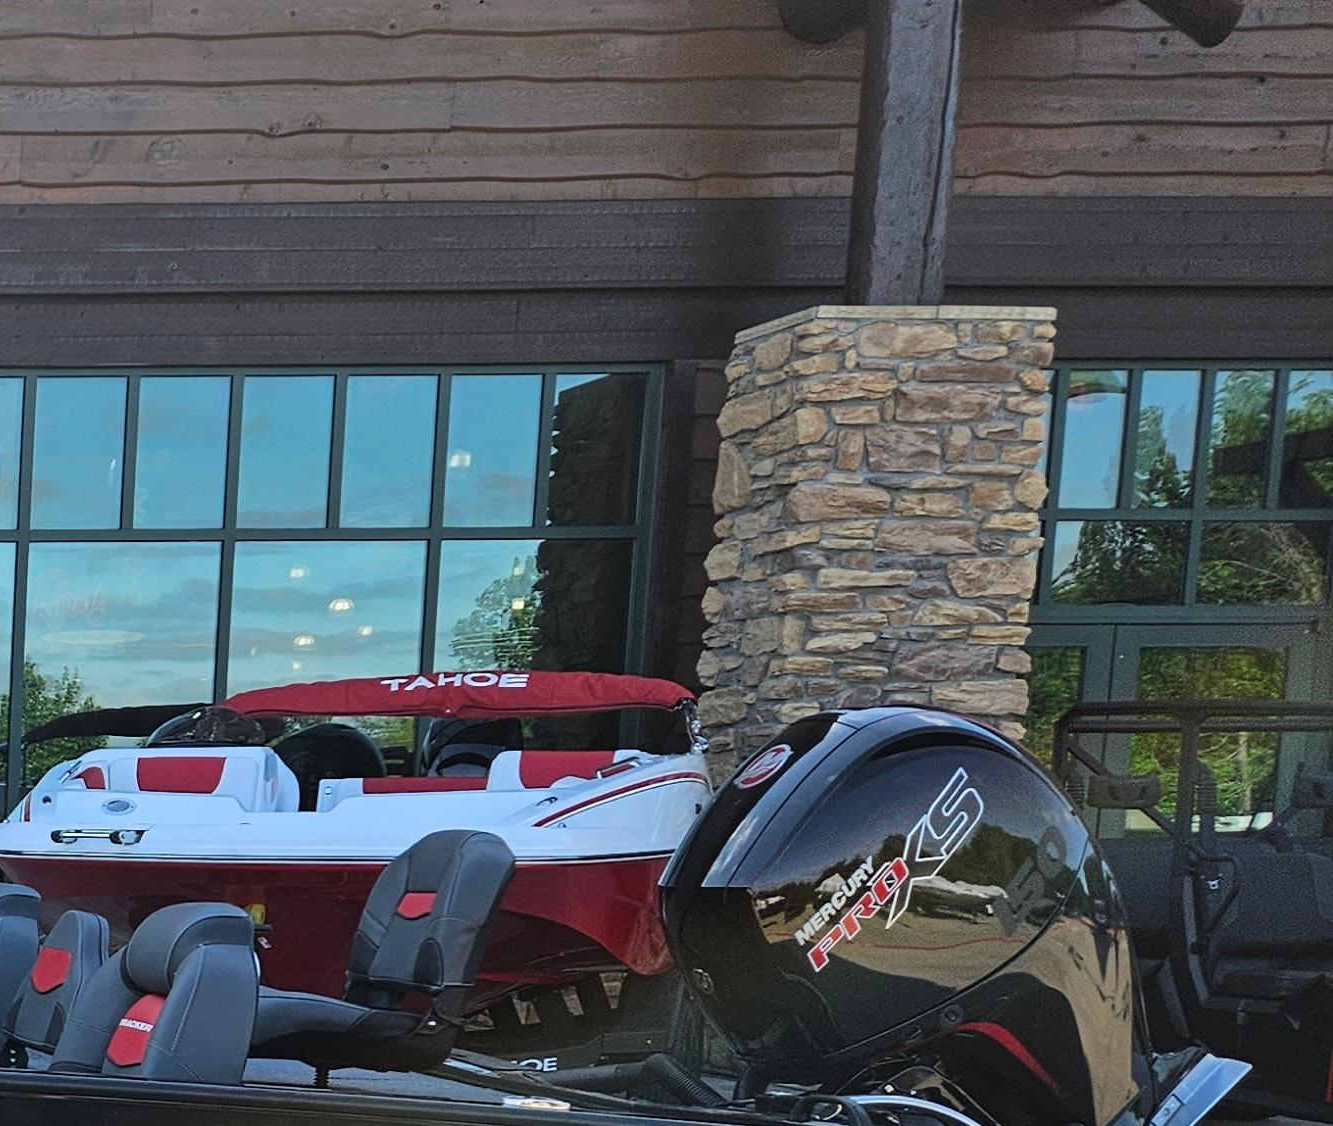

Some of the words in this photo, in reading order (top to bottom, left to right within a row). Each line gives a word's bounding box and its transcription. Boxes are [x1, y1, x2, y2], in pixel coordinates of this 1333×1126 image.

[381, 671, 530, 693] TAHOE
[794, 855, 875, 947] MERCURY
[806, 856, 910, 973] PRO
[885, 766, 984, 930] XS
